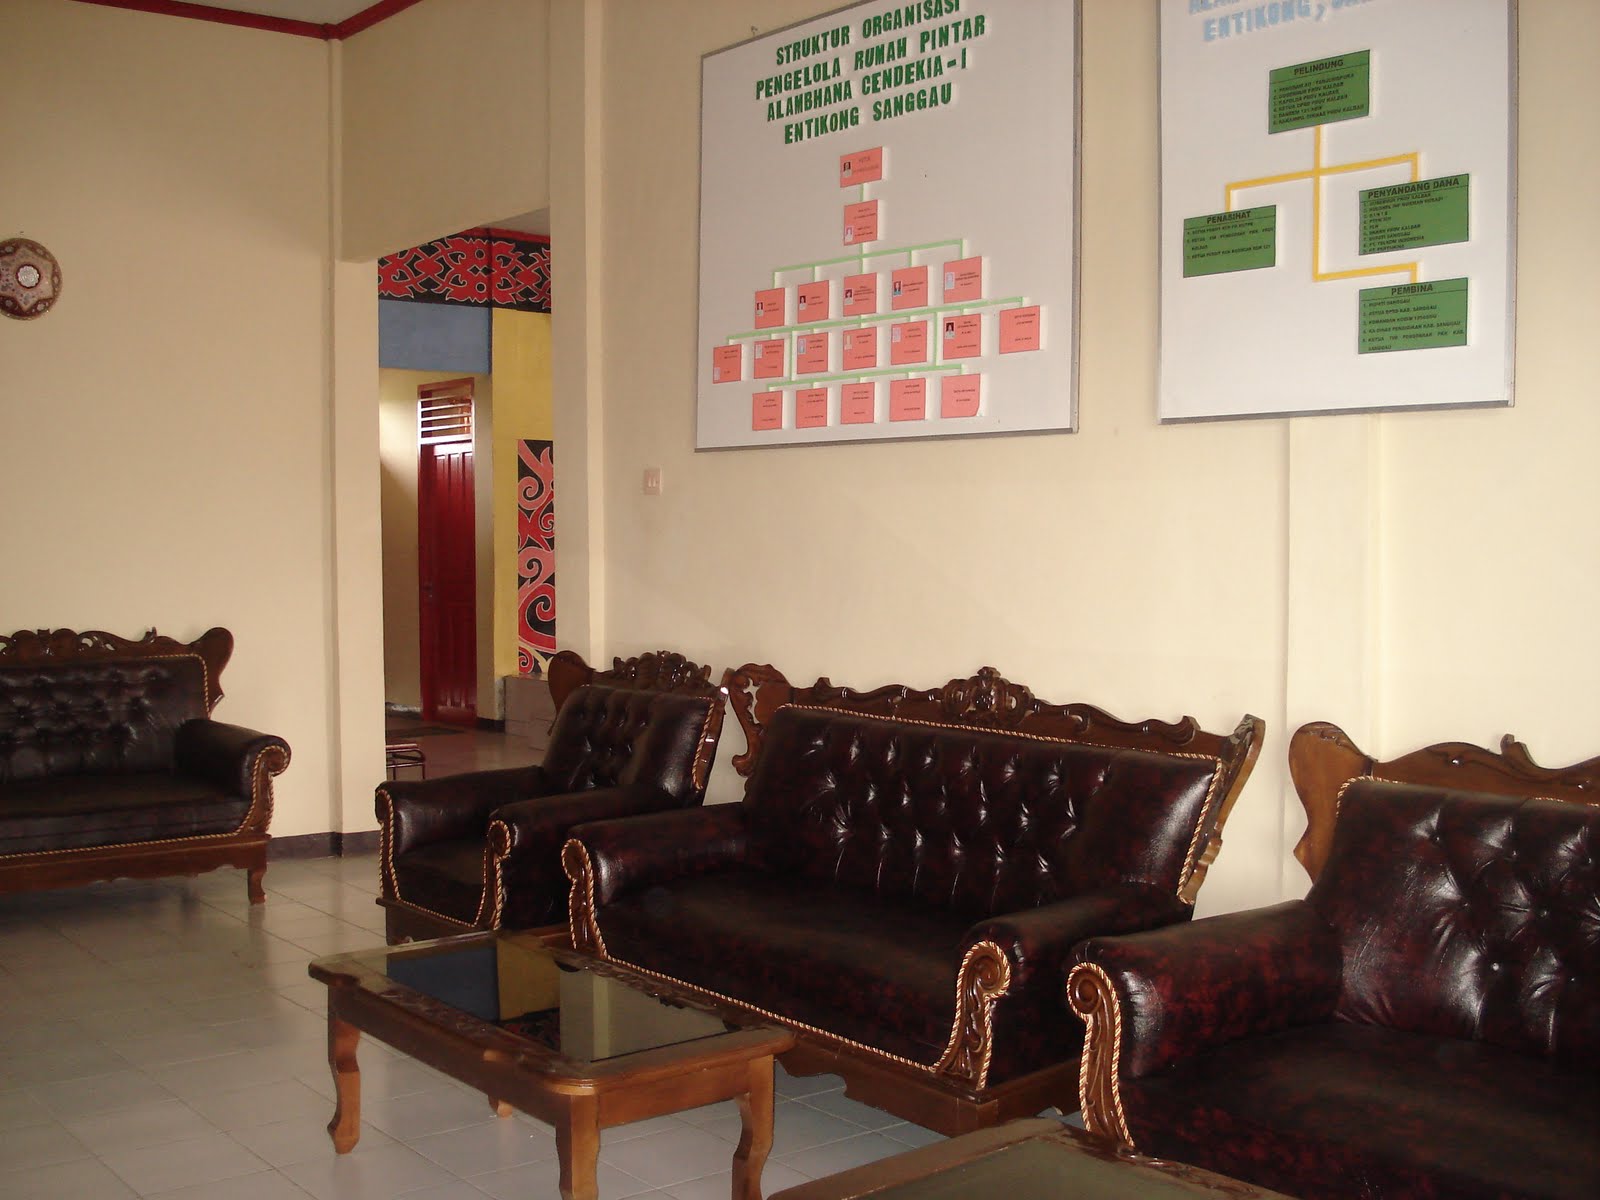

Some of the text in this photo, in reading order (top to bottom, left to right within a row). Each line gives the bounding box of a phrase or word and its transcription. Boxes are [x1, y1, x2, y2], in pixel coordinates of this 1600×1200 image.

[776, 0, 961, 66] STRUKTUR ORGANISASI
[756, 14, 986, 100] PENGELOLA RUMAH PINTAR
[1293, 59, 1344, 76] PELINDUNG
[767, 80, 853, 122] ALAMBHANA
[784, 82, 953, 145] ENTIKONG SANGGAU
[1368, 178, 1460, 199] PENYANDANG DANA
[1206, 211, 1251, 224] PENASIHAT
[1391, 283, 1434, 296] PEMBINA
